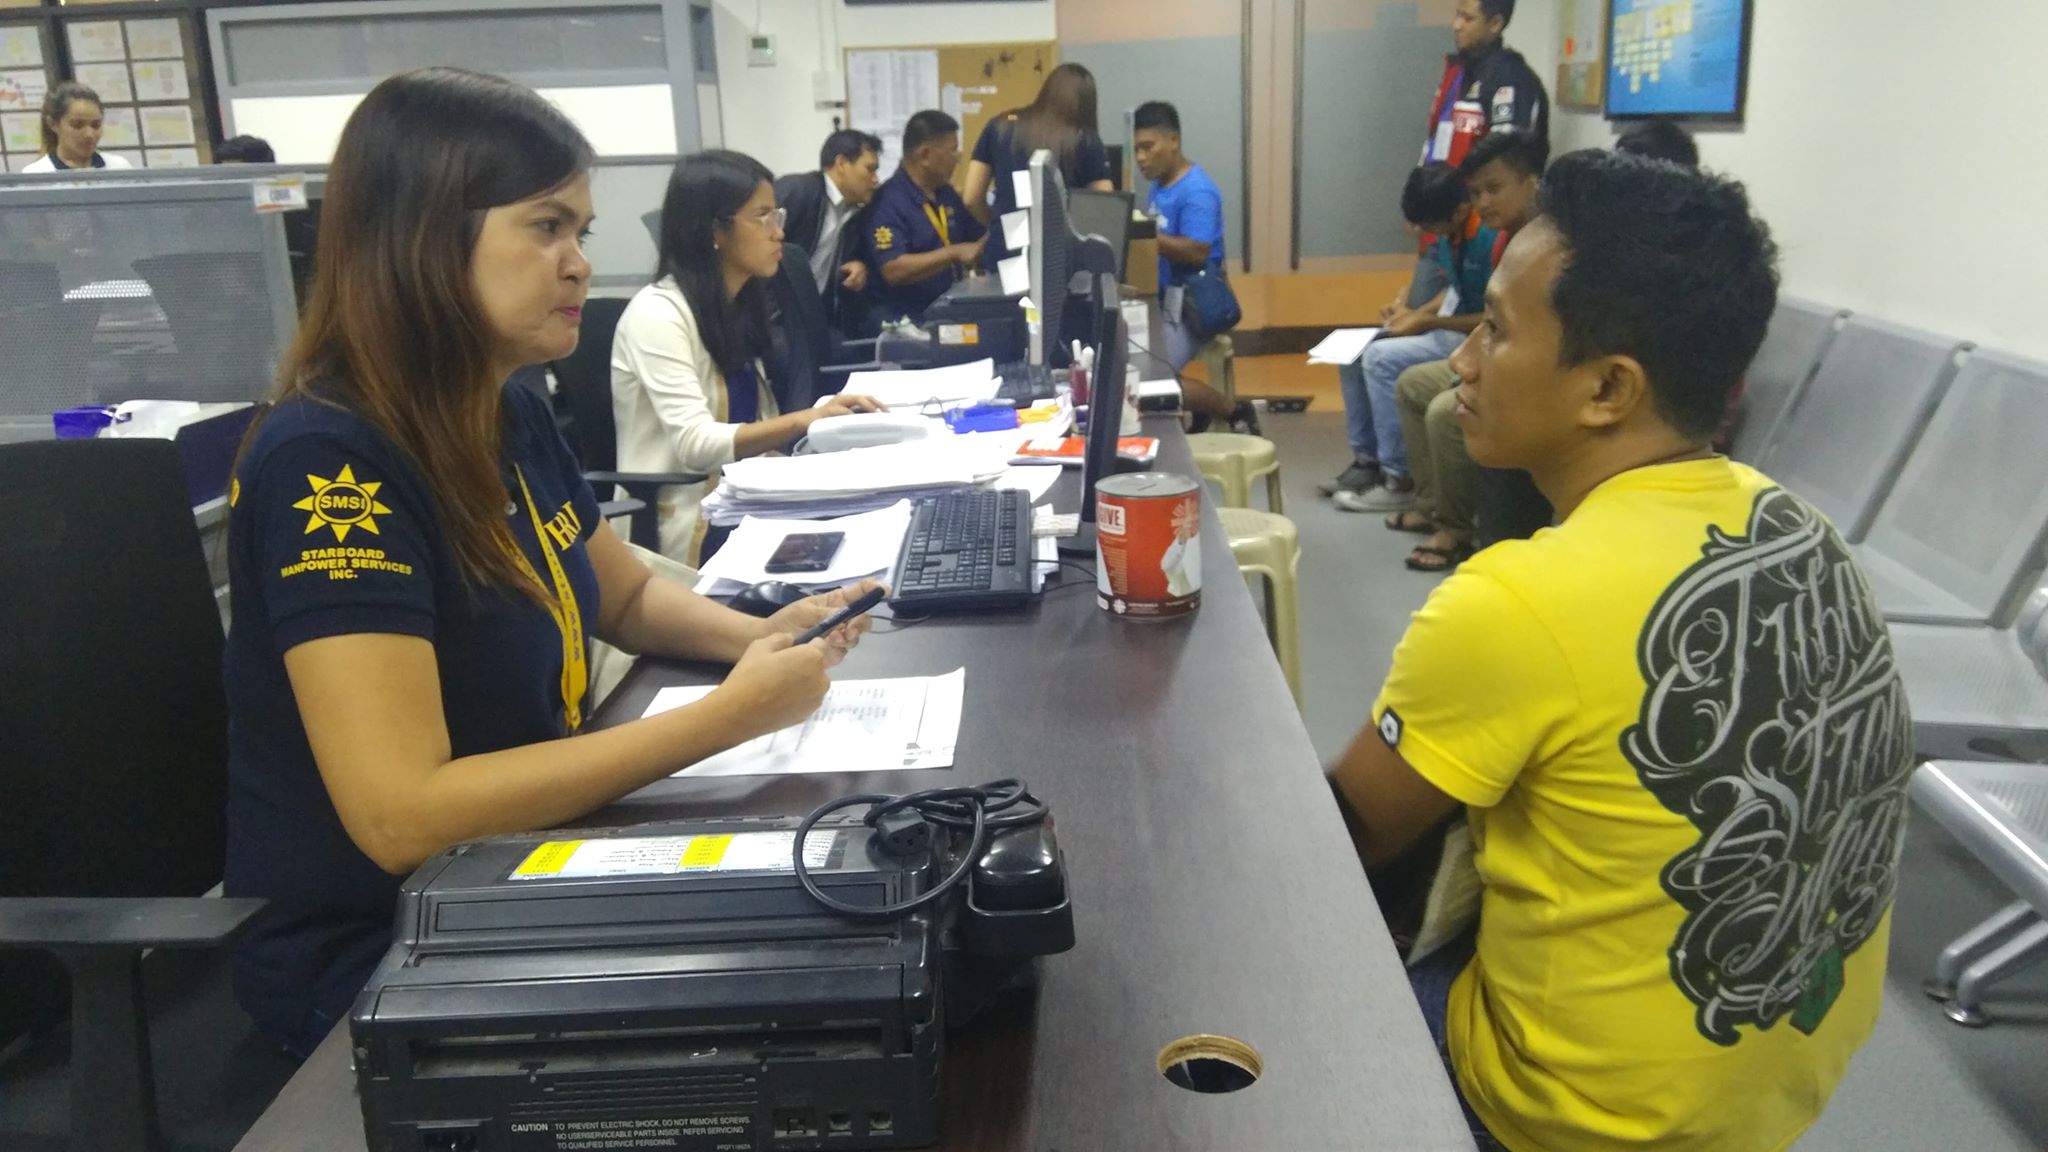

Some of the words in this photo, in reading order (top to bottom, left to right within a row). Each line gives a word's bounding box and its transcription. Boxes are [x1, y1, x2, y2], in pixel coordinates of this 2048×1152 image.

[320, 495, 366, 510] SMSI
[301, 547, 385, 561] STARBOARD
[280, 558, 347, 578] MANPOWER
[351, 558, 413, 576] SERVICES
[329, 569, 358, 580] INC.
[1628, 487, 1885, 780] Triba
[511, 1122, 549, 1132] CAUTION
[555, 1123, 565, 1131] TO
[567, 1121, 599, 1130] PREVENT
[601, 1120, 634, 1129] ELECTRIC
[662, 1118, 673, 1127] DO
[674, 1118, 688, 1126] NOT
[689, 1117, 719, 1126] REMOVE
[633, 1128, 657, 1137] PARTS
[683, 1127, 706, 1136] REFER
[707, 1126, 744, 1135] SERVICING
[557, 1142, 567, 1150] TO
[567, 1140, 604, 1149] QUALIFIED
[605, 1139, 634, 1148] SERVICE
